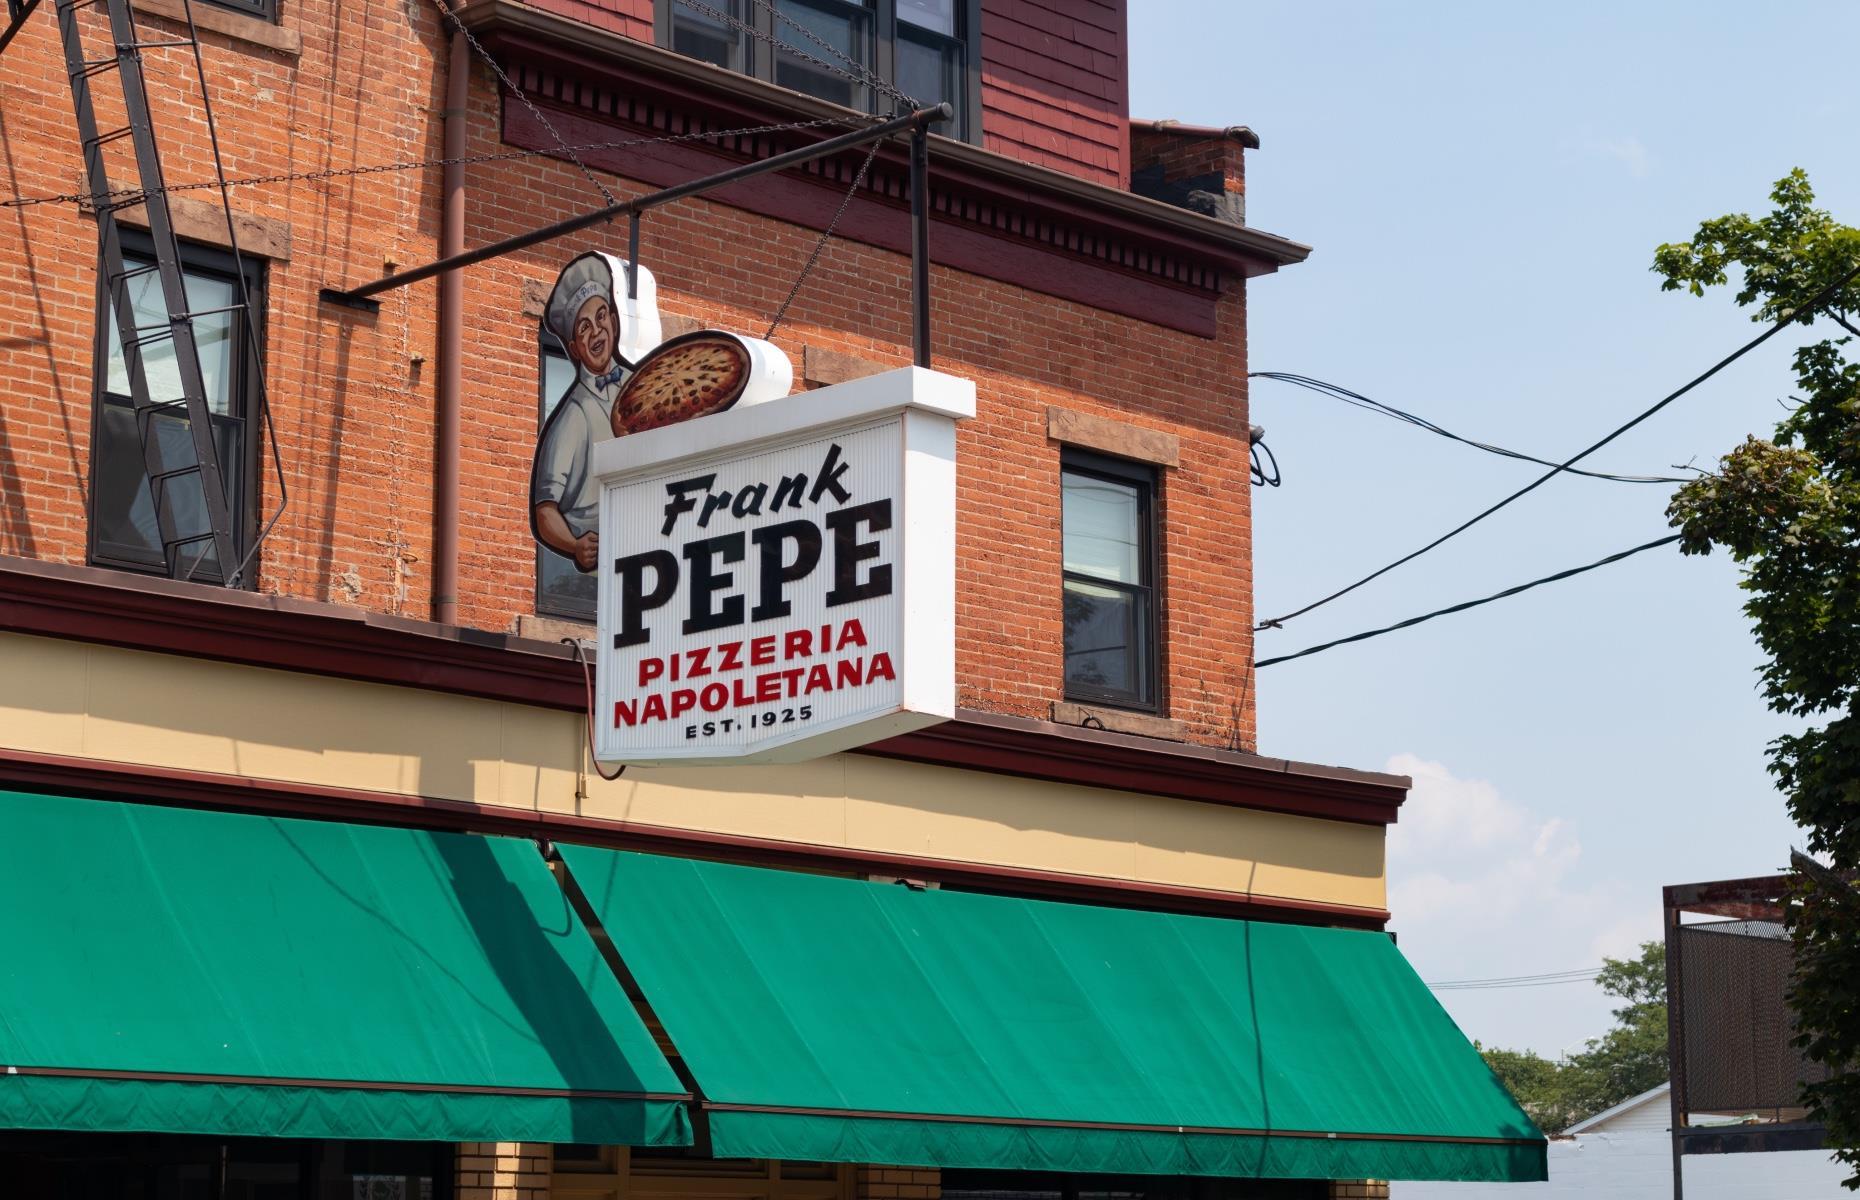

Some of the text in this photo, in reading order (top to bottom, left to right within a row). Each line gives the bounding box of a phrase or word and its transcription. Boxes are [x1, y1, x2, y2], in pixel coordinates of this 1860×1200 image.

[660, 443, 852, 537] Frank
[613, 497, 893, 650] PEPE
[613, 651, 896, 730] NAPOLETANA
[638, 618, 868, 688] PIZZERIA
[685, 704, 813, 740] EST. 1925
